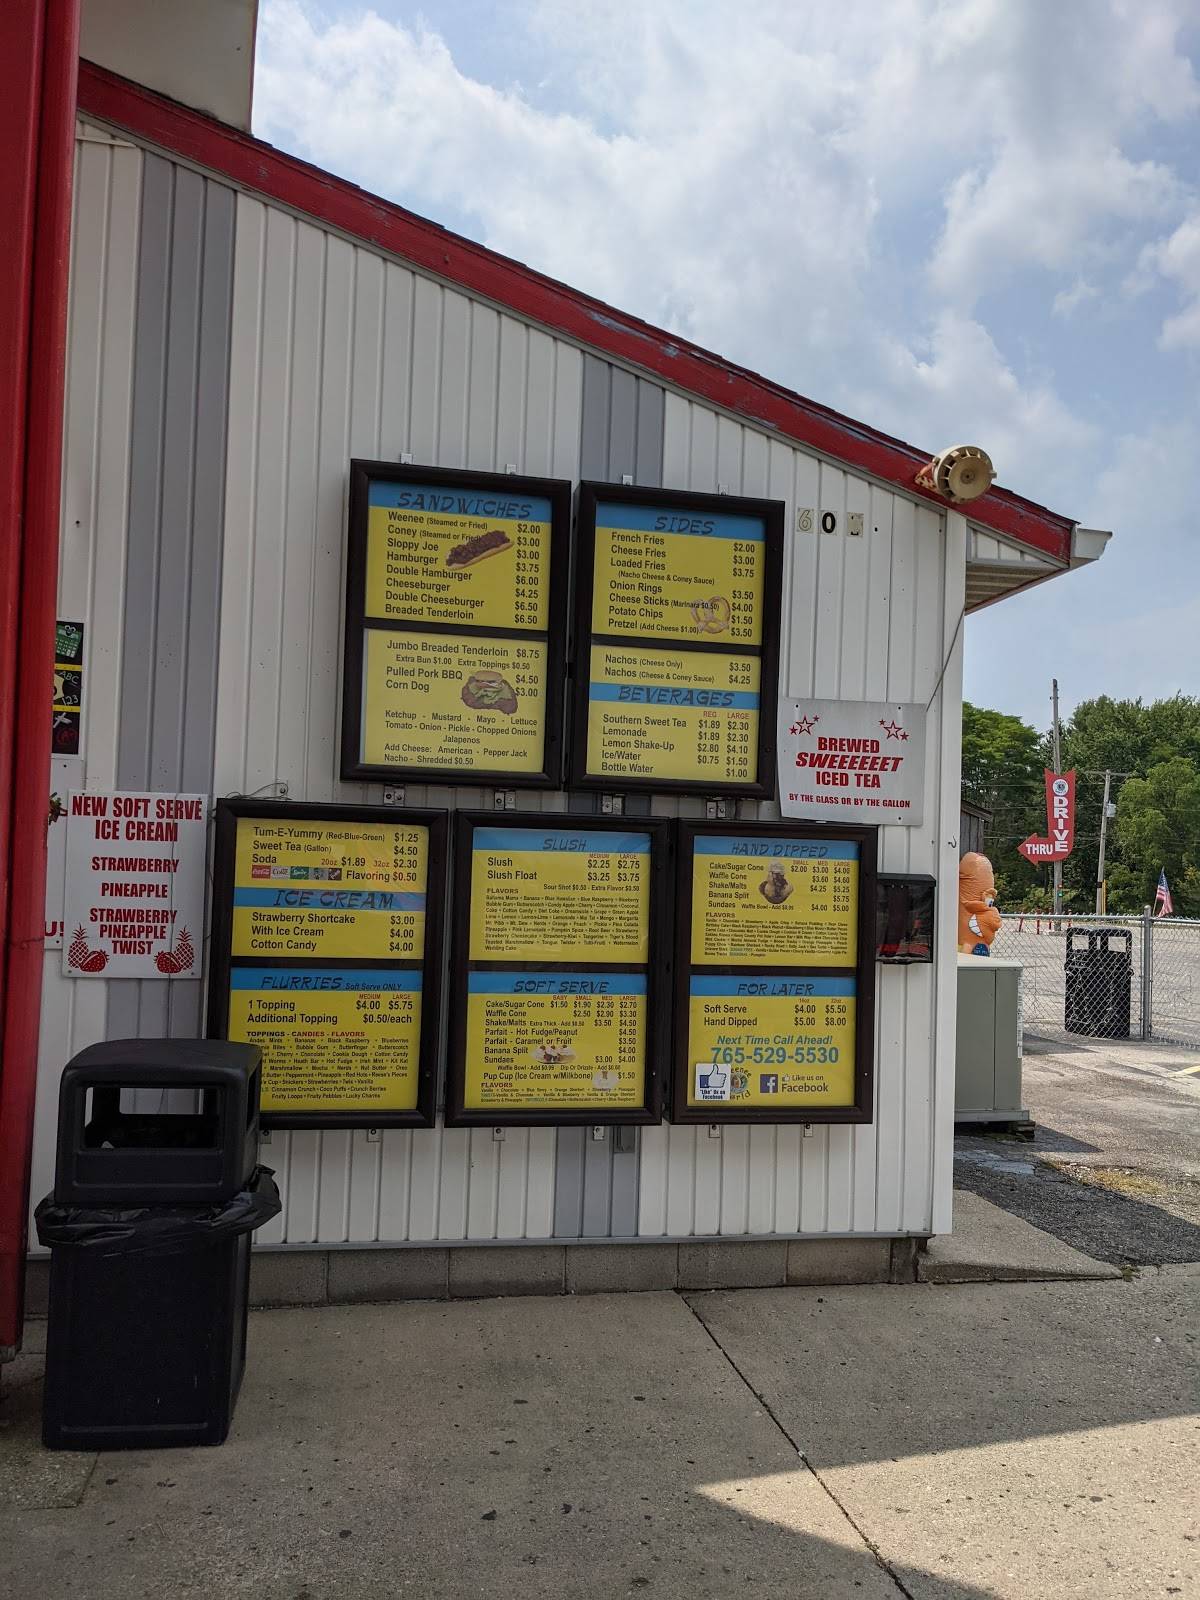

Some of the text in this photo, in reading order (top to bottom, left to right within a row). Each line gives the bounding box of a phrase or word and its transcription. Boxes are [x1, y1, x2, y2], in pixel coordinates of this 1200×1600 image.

[397, 493, 532, 518] SANDWICHES
[655, 516, 716, 534] SIDES
[387, 538, 539, 560] Sloppy Joe $3.00
[612, 532, 755, 553] French Fries $2.00
[387, 552, 539, 573] Hamburger $3.75
[611, 545, 754, 565] Cheese Fries $3.00
[387, 565, 539, 585] Double Hamburger $6.00
[611, 558, 754, 577] Loaded Fries $3.75
[386, 578, 538, 599] Cheeseburger $4.25
[610, 581, 753, 600] Onion Rings $3.50
[386, 591, 538, 612] Double Cheeseburger $6.50
[385, 604, 537, 624] Breaded Tenderloin $6.50
[609, 606, 752, 625] Potato Chips $1.50
[387, 640, 539, 659] Jumbo Breaded Tenderloin $8.75
[386, 667, 538, 684] Pulled Pork BBQ $4.50
[386, 680, 538, 697] Corn Dog $3.00
[618, 686, 735, 706] BEVERAGES
[603, 714, 749, 731] Southern Sweet Tea $1.89 $2.30
[603, 727, 748, 743] Lemonade $1.89 $2.30
[603, 739, 748, 754] Lemon Shake-Up $2.80 $4.10
[818, 737, 879, 753] BREWED
[602, 750, 748, 766] Ice/Water $0.75 $1.50
[796, 753, 903, 772] SWEEEEEET
[602, 762, 747, 778] Bottle Water $1.00
[816, 772, 880, 788] ICED TEA
[72, 795, 202, 820] NEW SOFT SERVE
[789, 793, 910, 807] BY THE GLASS OR BY THE GALLON
[95, 820, 178, 841] ICE CREAM
[1053, 796, 1068, 852] DRIVE
[543, 838, 587, 850] SLUSH
[731, 843, 828, 857] HAND DIPPED
[1026, 843, 1053, 855] THRU
[92, 857, 179, 872] STRAWBERRY
[488, 857, 639, 869] Slush $2.25 $2.75
[488, 870, 639, 882] Slush Float $3.25 $3.75
[101, 883, 167, 897] PINEAPPLE
[274, 890, 393, 908] ICE CREAM
[90, 909, 177, 923] STRAWBERRY
[252, 913, 414, 925] Strawberry Shortcake $3.00
[99, 924, 166, 939] PINEAPPLE
[252, 926, 413, 938] With Ice Cream $4.00
[112, 940, 153, 955] TWIST
[251, 939, 413, 952] Cotton Candy $4.00
[261, 976, 343, 989] FLURRIES
[514, 981, 610, 993] SOFT SERVE
[738, 984, 814, 995] FOR LATER
[256, 1000, 295, 1011] Topping
[356, 1001, 380, 1010] $4.00
[389, 1001, 412, 1010] $5.75
[704, 1005, 846, 1014] Soft Serve $4.00 $5.50
[248, 1014, 412, 1025] Additional Topping $0.50/each
[704, 1017, 846, 1027] Hand Dipped $5.00 $8.00
[717, 1036, 832, 1044] Next Time Call Ahead!
[711, 1047, 839, 1064] 765-529-5530
[781, 1083, 828, 1092] Facebook
